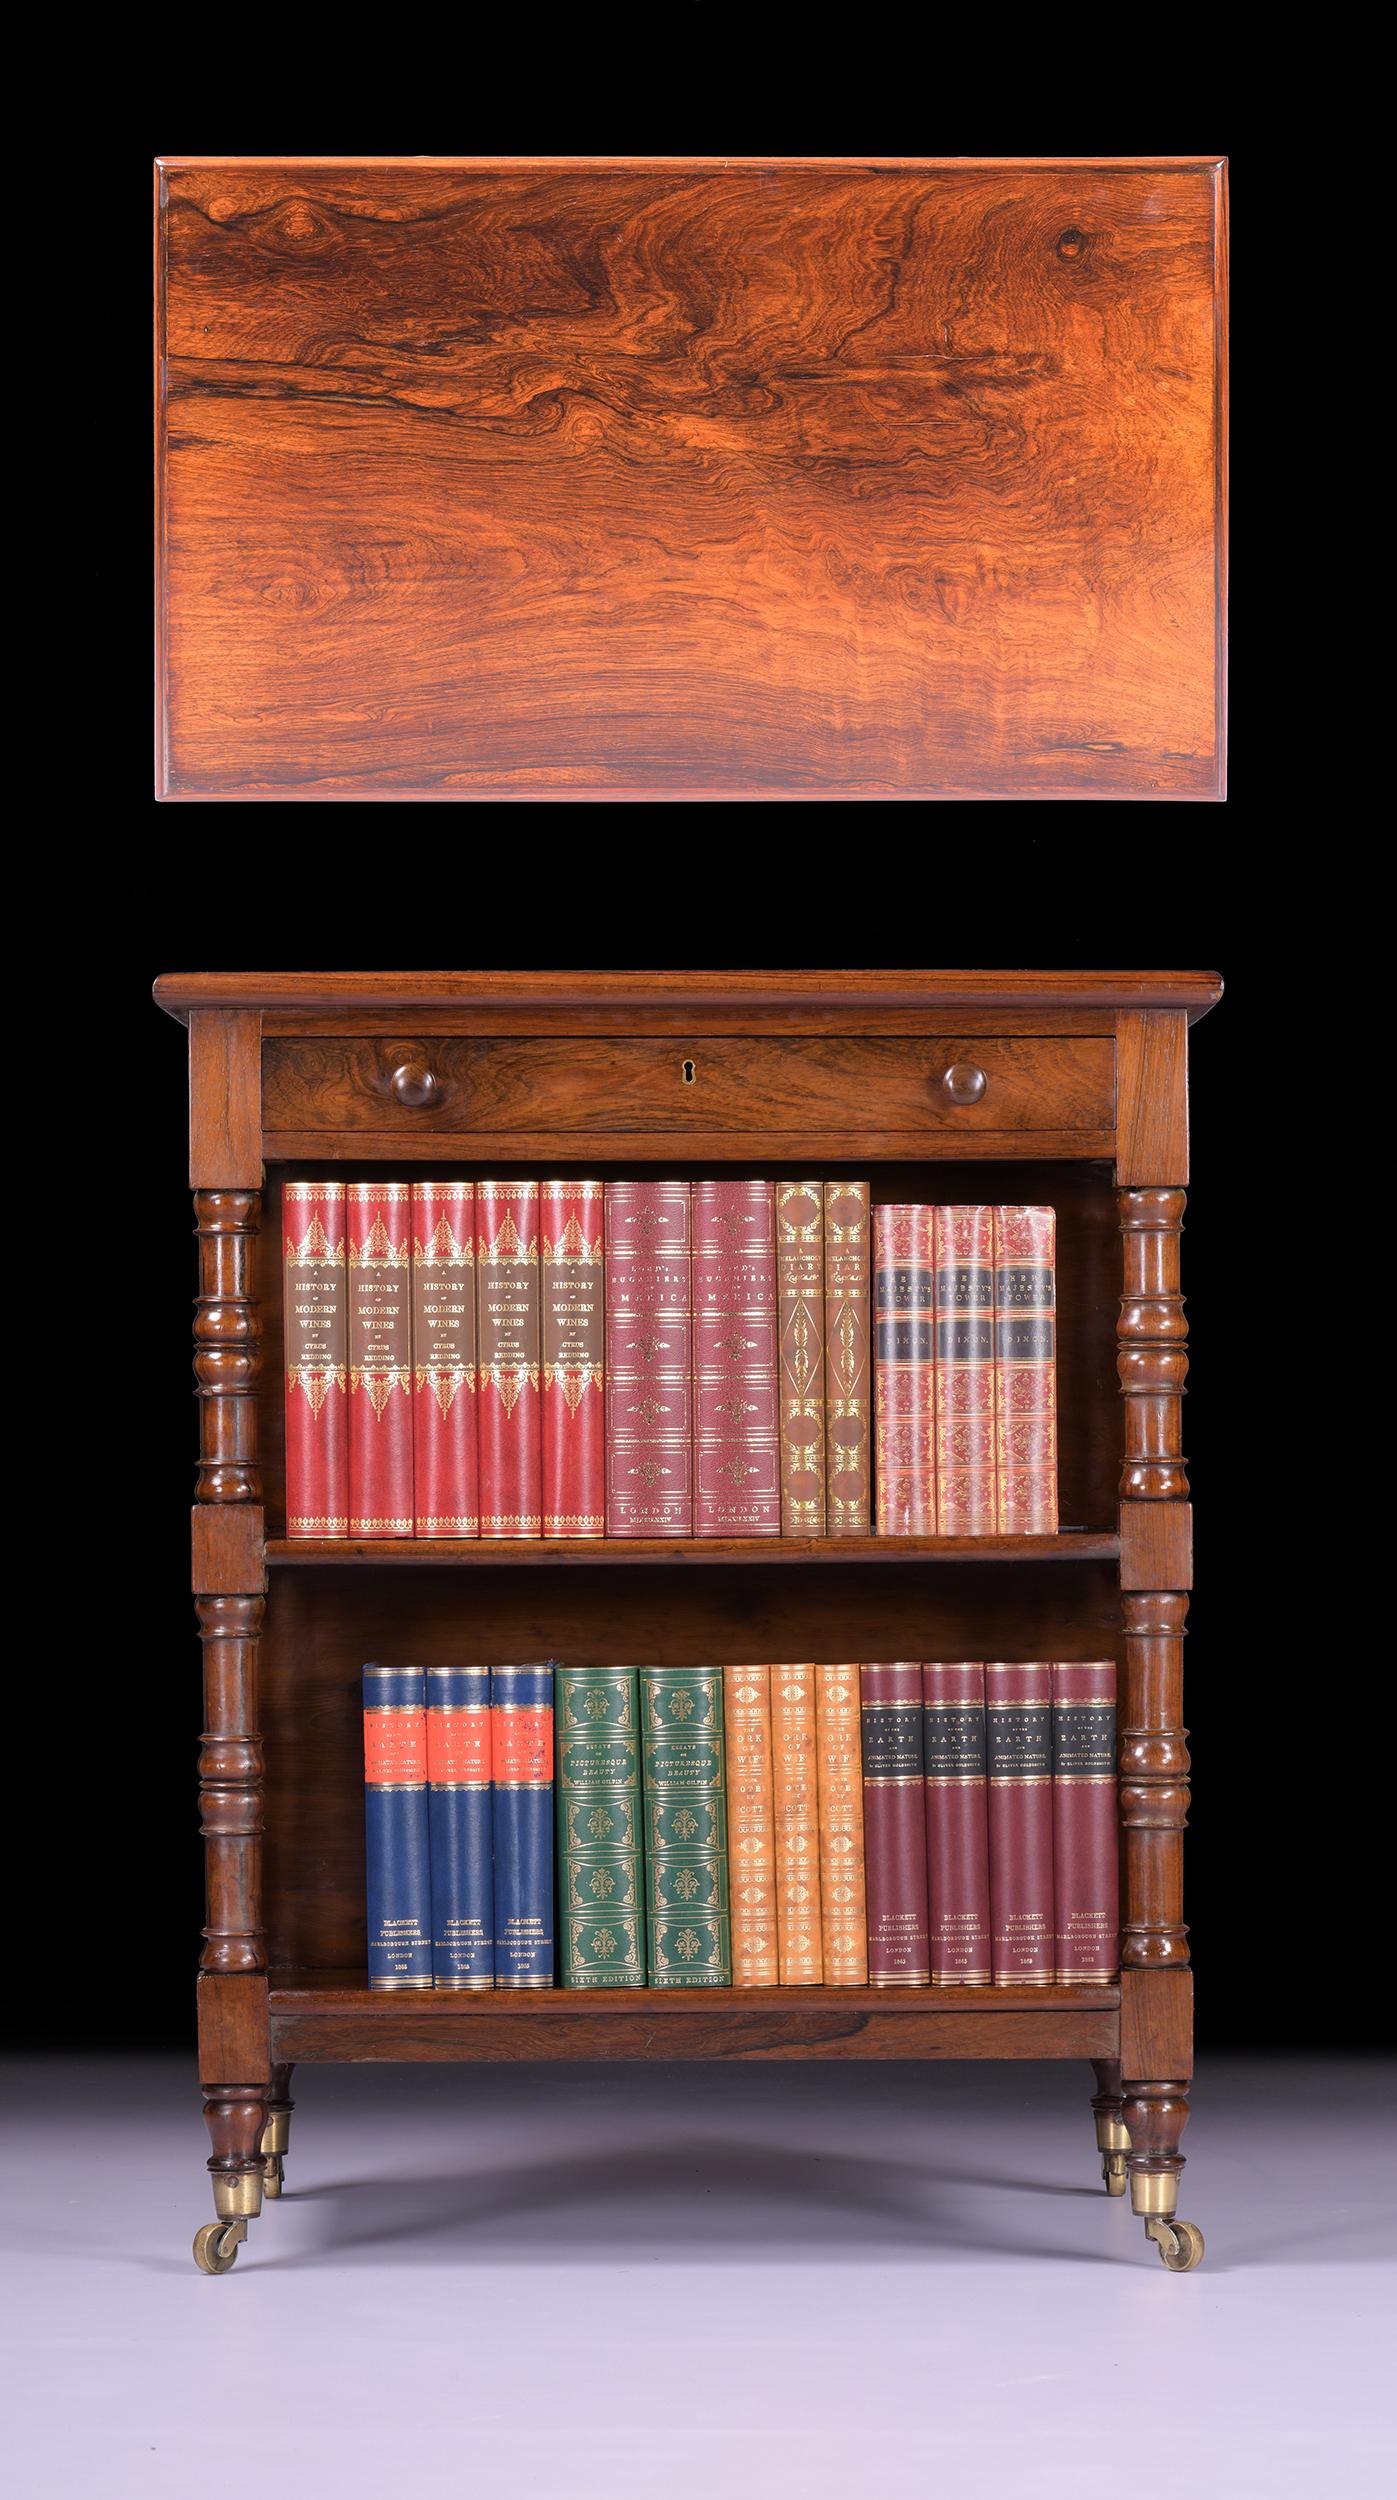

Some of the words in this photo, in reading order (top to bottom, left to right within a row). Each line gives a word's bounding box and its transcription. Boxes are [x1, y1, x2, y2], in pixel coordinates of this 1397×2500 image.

[295, 1283, 337, 1291] HISTORY
[358, 1284, 399, 1292] HISTORY
[423, 1283, 465, 1291] HISTORY
[487, 1282, 530, 1290] HISTORY
[552, 1282, 594, 1290] HISTORY
[695, 1293, 774, 1301] MERICA
[295, 1305, 337, 1314] MODERN
[358, 1306, 400, 1315] MODERN
[423, 1305, 465, 1313] MODERN
[487, 1304, 530, 1312] MODERN
[552, 1304, 594, 1312] MODERN
[299, 1320, 331, 1328] WINES
[362, 1321, 394, 1329] WINES
[427, 1320, 460, 1328] WINES
[491, 1318, 524, 1327] WINES
[556, 1318, 589, 1327] WINES
[932, 1735, 977, 1743] EARTH
[996, 1735, 1042, 1743] EARTH
[1060, 1734, 1108, 1742] EARTH
[570, 1759, 627, 1767] PICTURESQUE
[655, 1760, 712, 1768] PICTURESQUE
[582, 1768, 616, 1776] BEAUTY
[602, 1975, 641, 1983] EDITION
[686, 1976, 724, 1984] EDITION
